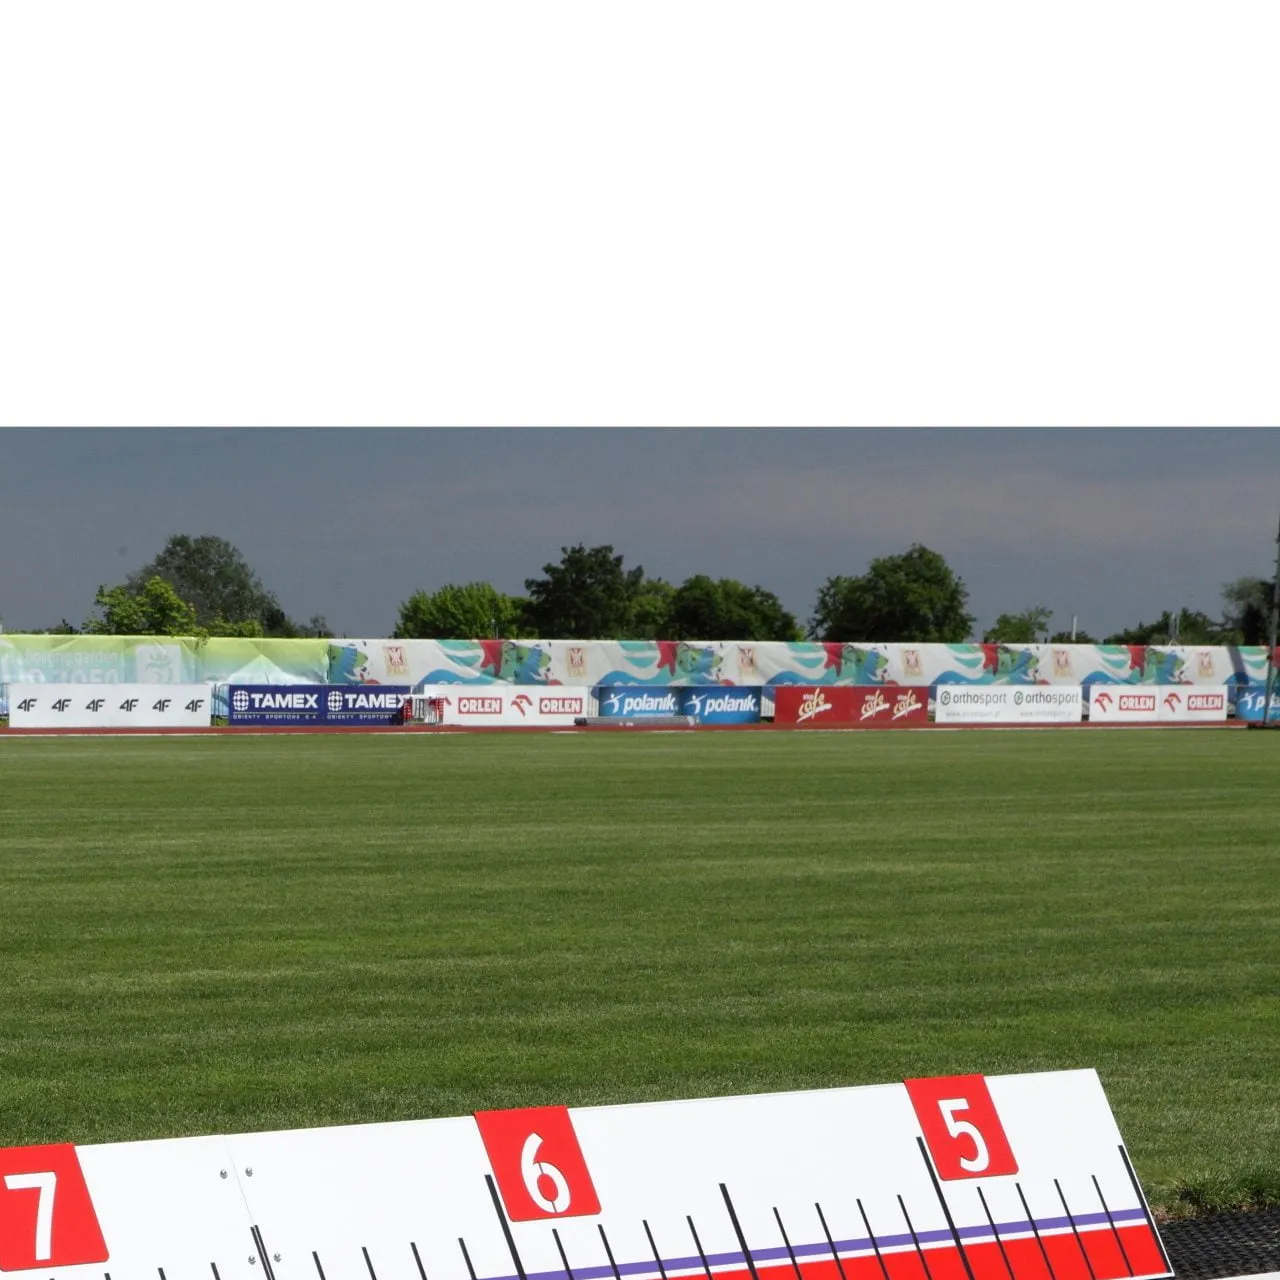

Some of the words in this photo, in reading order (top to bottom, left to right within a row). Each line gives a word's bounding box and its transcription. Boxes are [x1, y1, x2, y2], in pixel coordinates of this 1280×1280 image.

[17, 698, 37, 712] 4F
[51, 698, 72, 712] 4F
[85, 698, 105, 712] 4F
[119, 698, 139, 712] 4F
[152, 698, 172, 712] 4F
[184, 698, 204, 712] 4F
[251, 693, 318, 709] TAMEX
[460, 699, 501, 713] ORLEN
[541, 699, 581, 713] ORLEN
[623, 693, 677, 713] polanik
[704, 694, 756, 715] polanik
[953, 692, 1007, 706] orthosport
[1026, 692, 1079, 706] orthosport
[1120, 697, 1154, 710] ORLEN
[1188, 696, 1222, 709] ORLEN
[937, 1097, 991, 1173] 5
[520, 1132, 570, 1214] 6
[3, 1170, 57, 1261] 7
